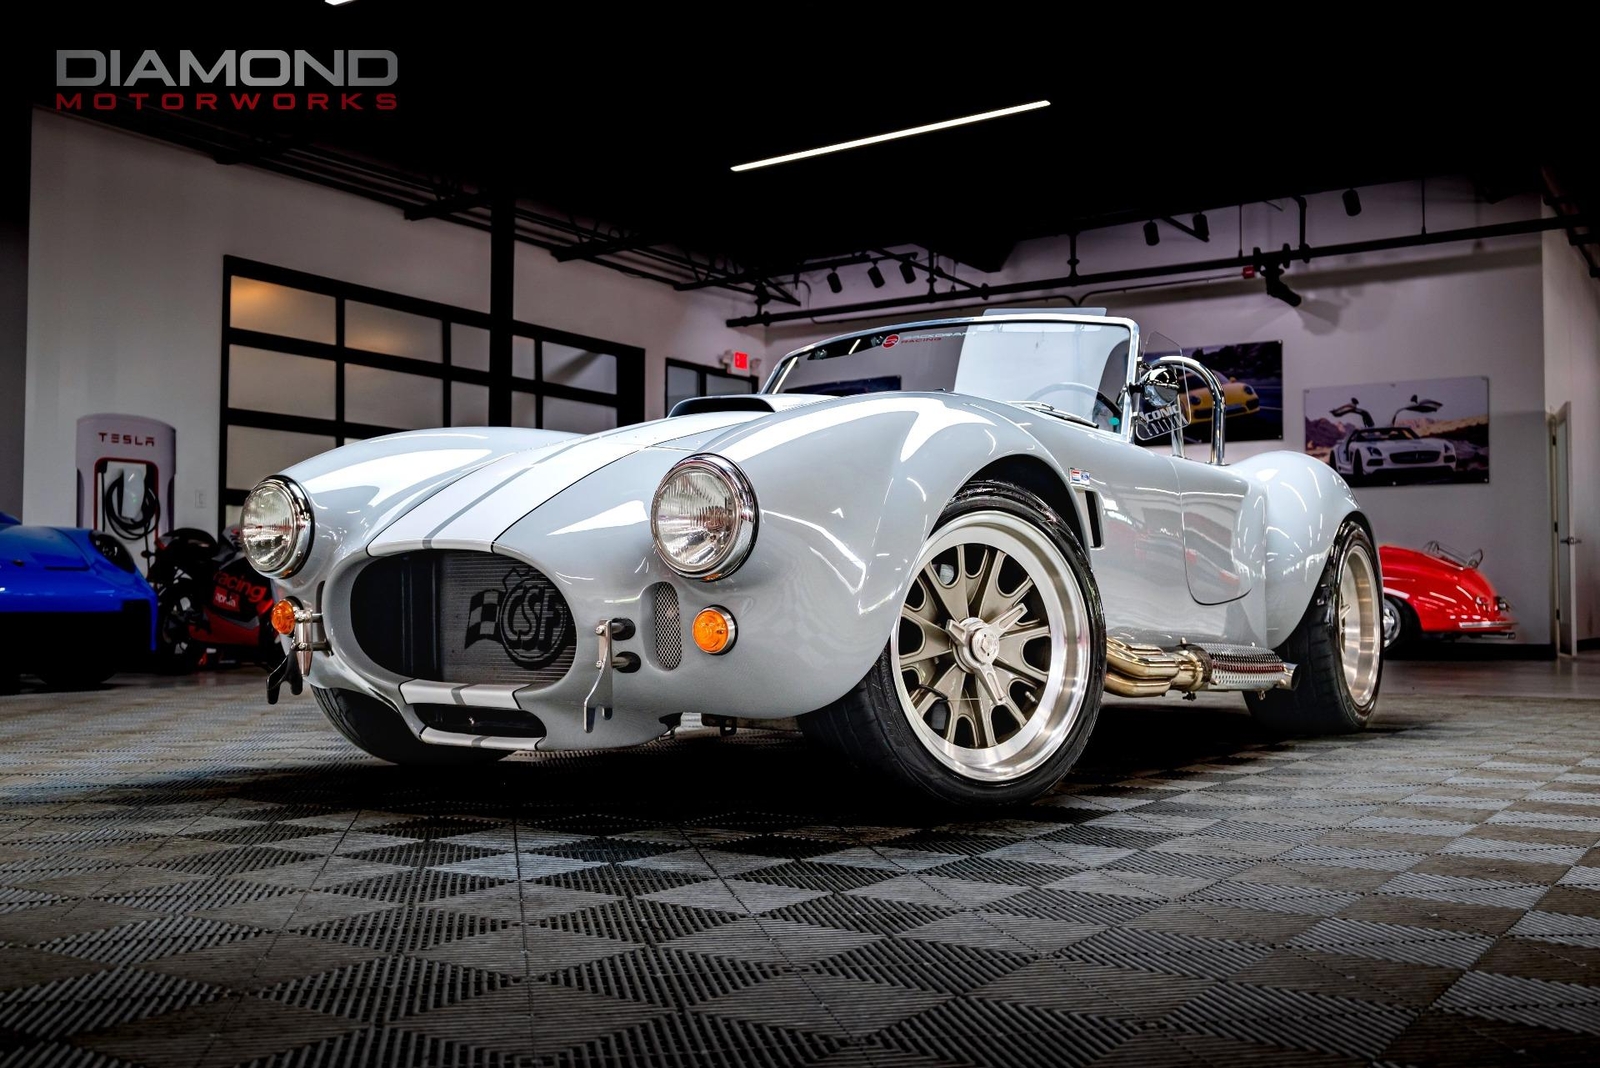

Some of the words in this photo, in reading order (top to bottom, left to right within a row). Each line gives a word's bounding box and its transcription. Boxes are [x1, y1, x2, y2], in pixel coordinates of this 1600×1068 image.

[901, 337, 942, 345] RACING
[98, 432, 155, 447] TESLA
[503, 585, 559, 647] CSF
